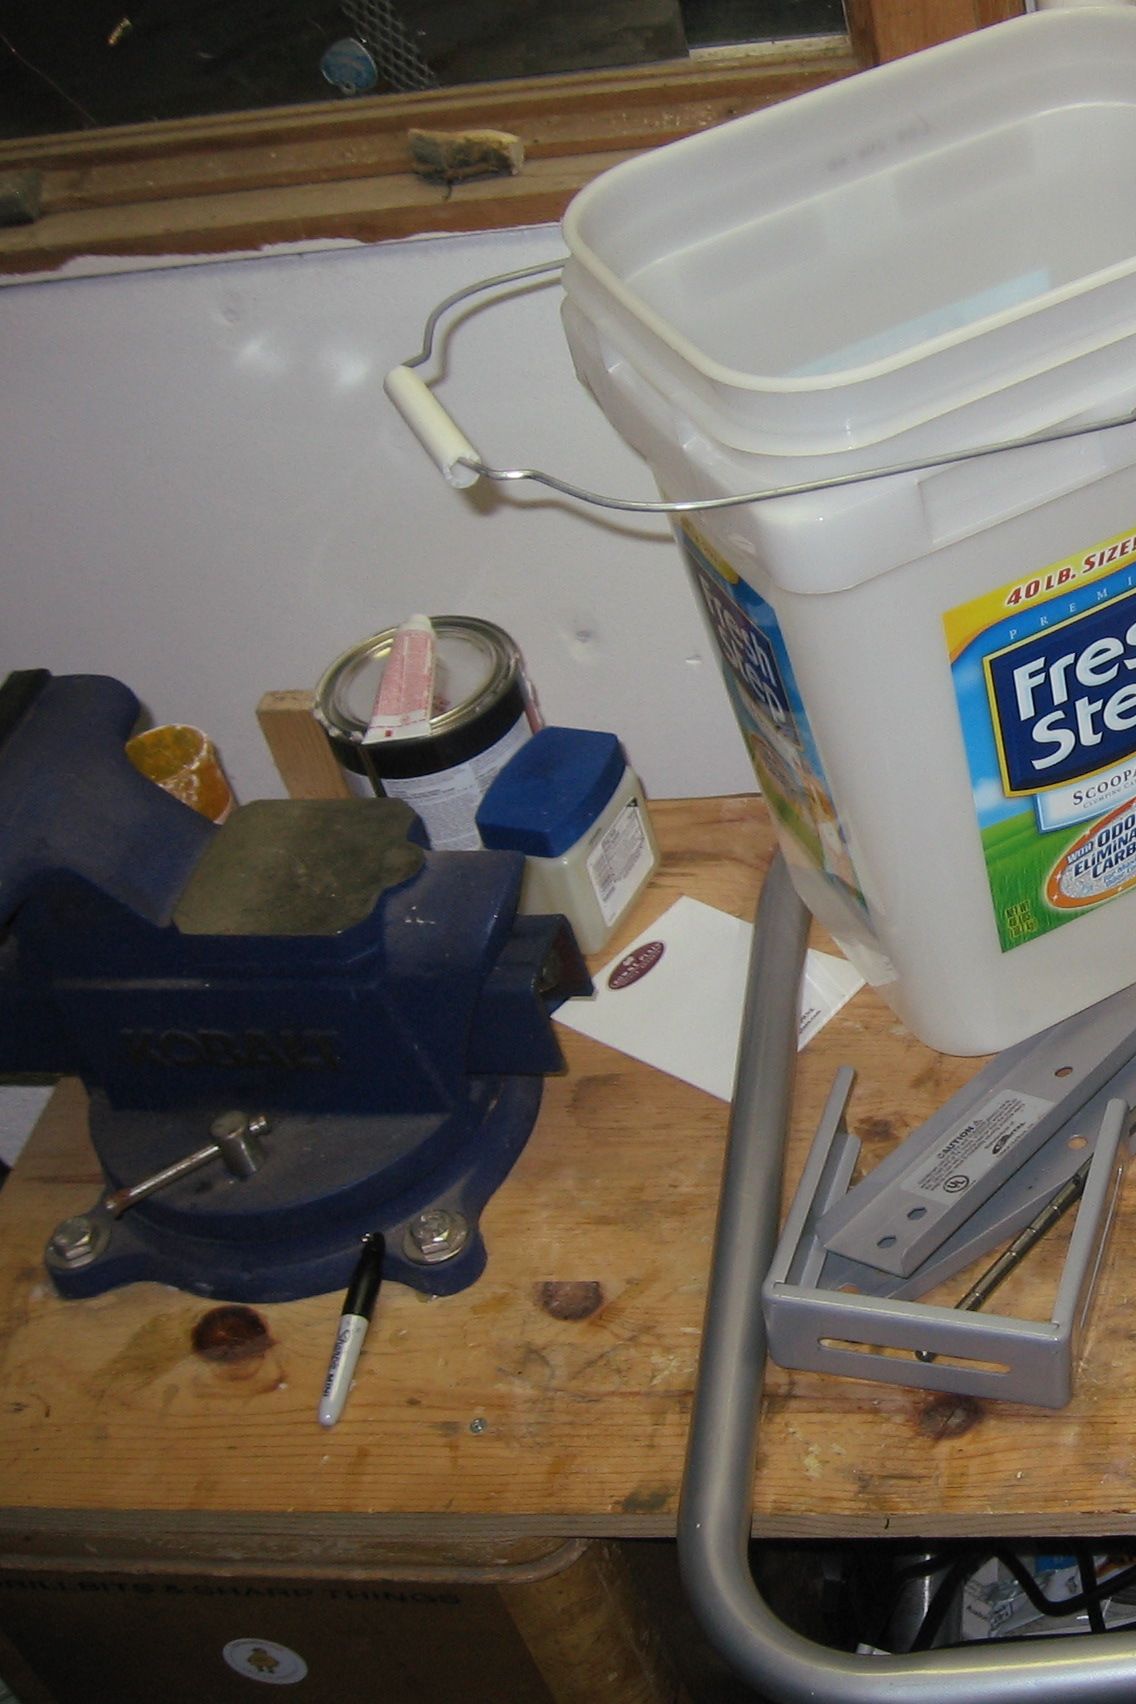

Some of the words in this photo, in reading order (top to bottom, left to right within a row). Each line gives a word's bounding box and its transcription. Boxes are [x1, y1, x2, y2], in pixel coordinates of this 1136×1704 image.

[1006, 580, 1040, 606] 40
[1045, 567, 1076, 590] LB.
[937, 1125, 975, 1159] CAUTION
